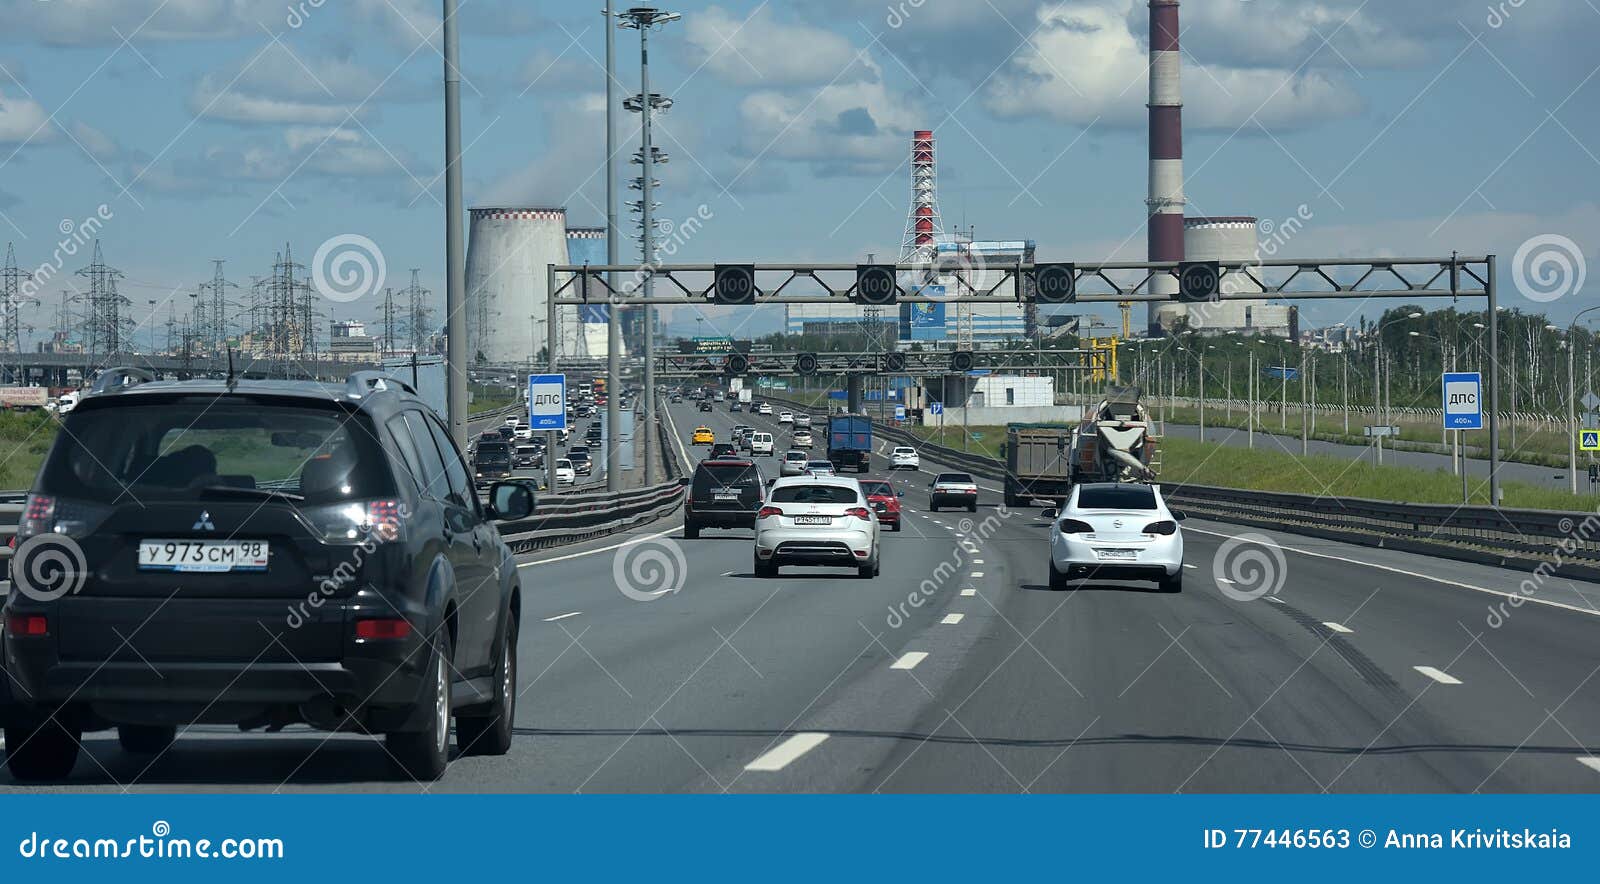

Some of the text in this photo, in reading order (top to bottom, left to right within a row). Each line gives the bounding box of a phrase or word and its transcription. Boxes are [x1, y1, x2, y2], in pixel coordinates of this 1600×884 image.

[720, 278, 748, 292] 100
[863, 278, 890, 292] 100
[1041, 277, 1069, 291] 100
[1185, 275, 1213, 289] 100
[535, 394, 560, 406] ДПС
[1449, 393, 1475, 405] ДПС
[241, 542, 261, 558] 98
